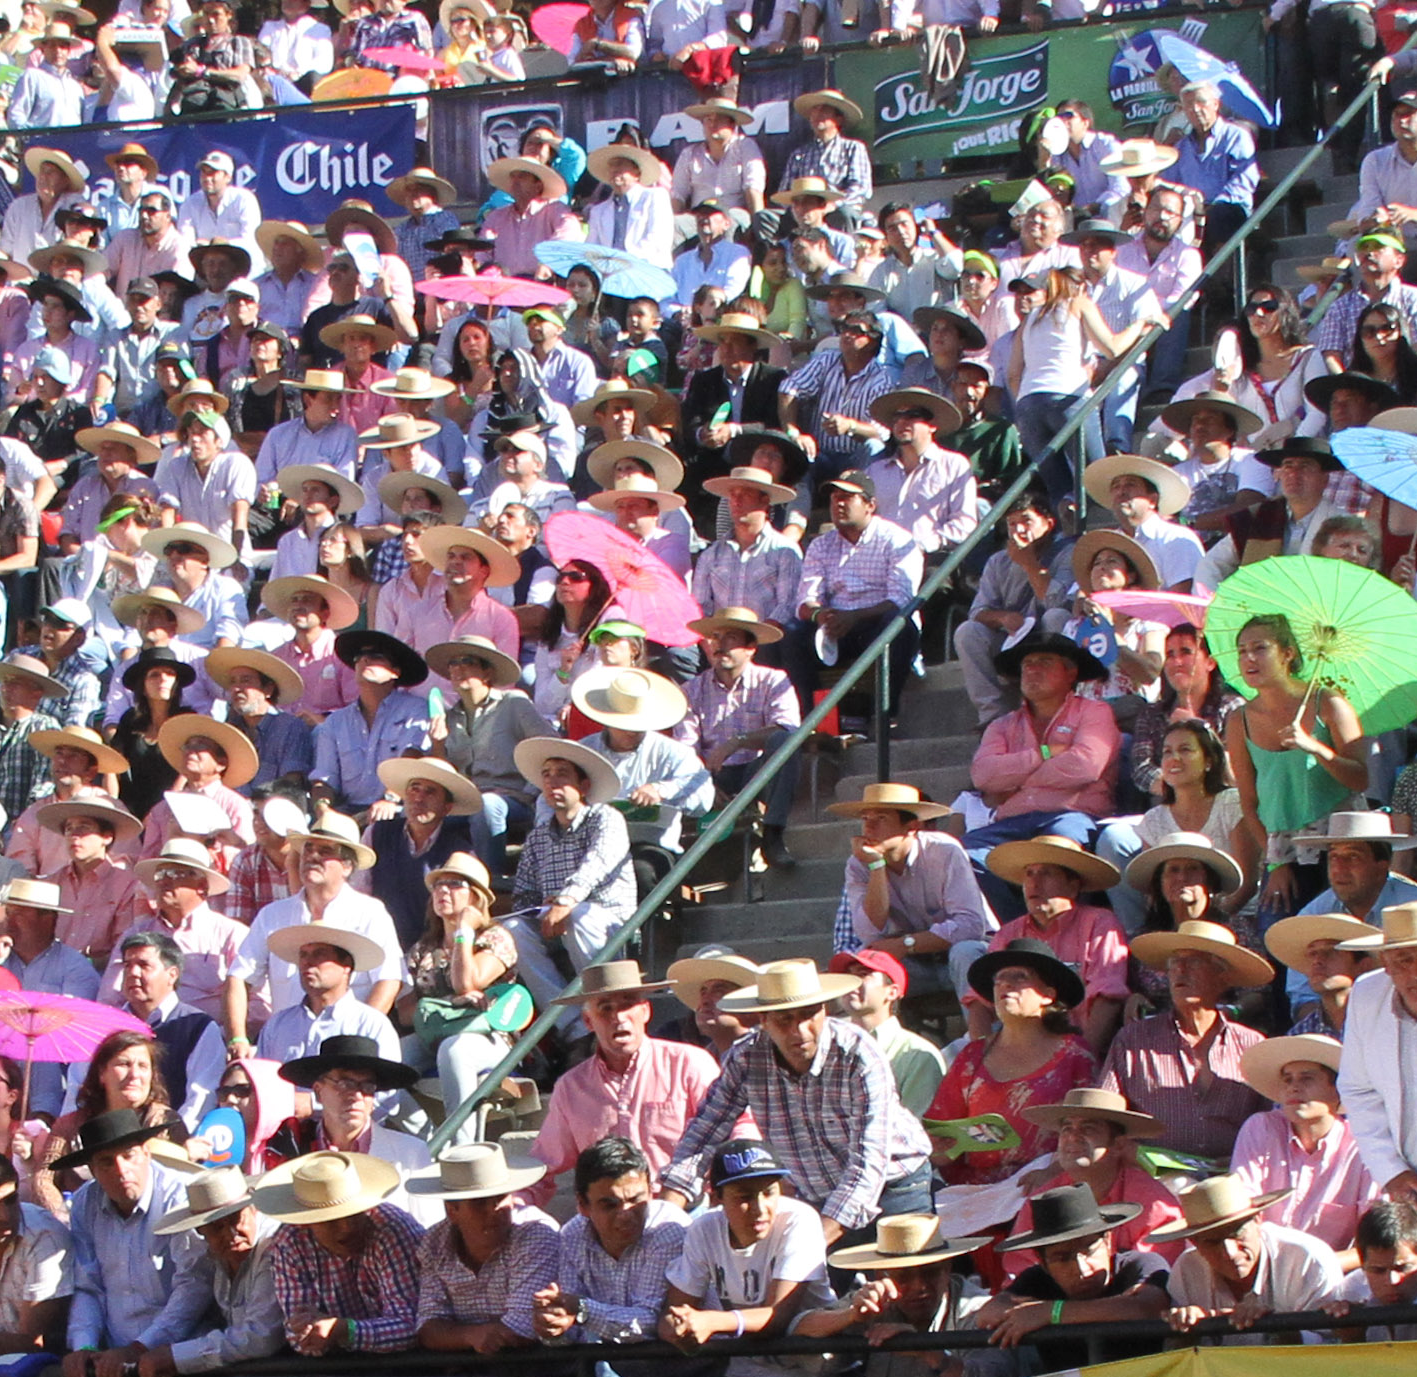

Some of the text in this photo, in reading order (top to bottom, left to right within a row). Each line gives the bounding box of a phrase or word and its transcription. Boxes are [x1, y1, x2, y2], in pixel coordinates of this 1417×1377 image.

[881, 69, 1041, 122] Sa Jorge
[986, 119, 1021, 146] RIC
[276, 140, 394, 195] Chile
